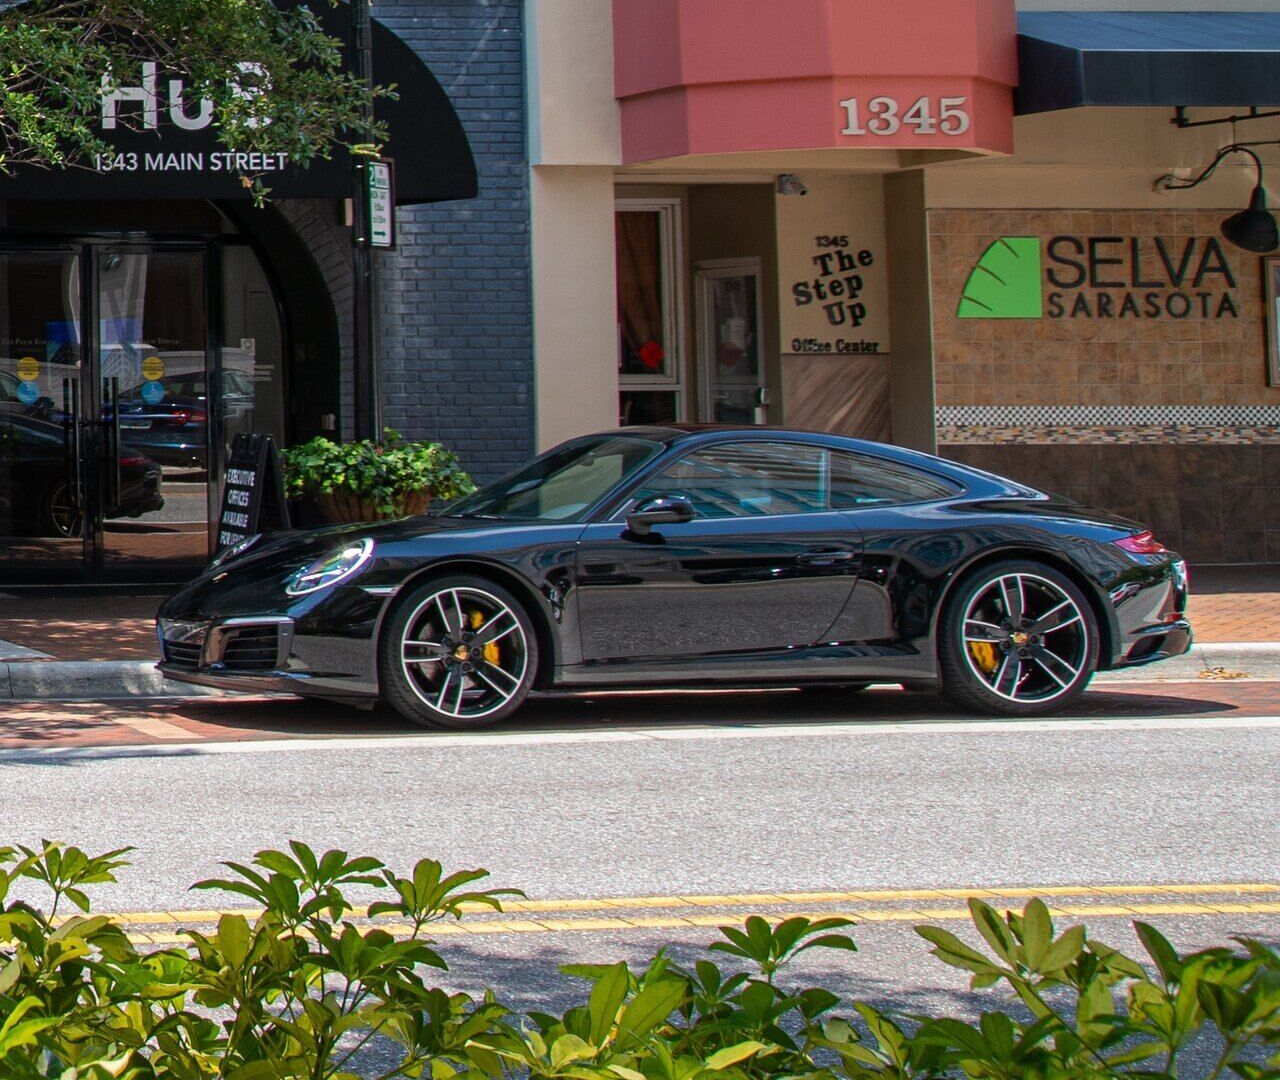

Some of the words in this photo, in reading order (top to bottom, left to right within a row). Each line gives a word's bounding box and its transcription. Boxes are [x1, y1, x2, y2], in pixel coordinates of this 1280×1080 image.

[840, 96, 970, 135] 1345
[94, 152, 138, 171] 1343
[145, 152, 203, 171] MAIN
[210, 152, 288, 171] STREET
[814, 235, 849, 248] 1345
[812, 249, 873, 277] The
[1046, 235, 1237, 289] SELVA
[792, 274, 863, 307] Step
[822, 301, 866, 328] Up
[1048, 291, 1238, 319] SARASOTA
[792, 338, 832, 352] Office
[835, 338, 879, 352] Center
[226, 468, 255, 487] EXECUTIVE
[228, 489, 249, 506] OFFICES
[222, 510, 248, 528] AVAILABLE
[220, 531, 231, 545] FOR
